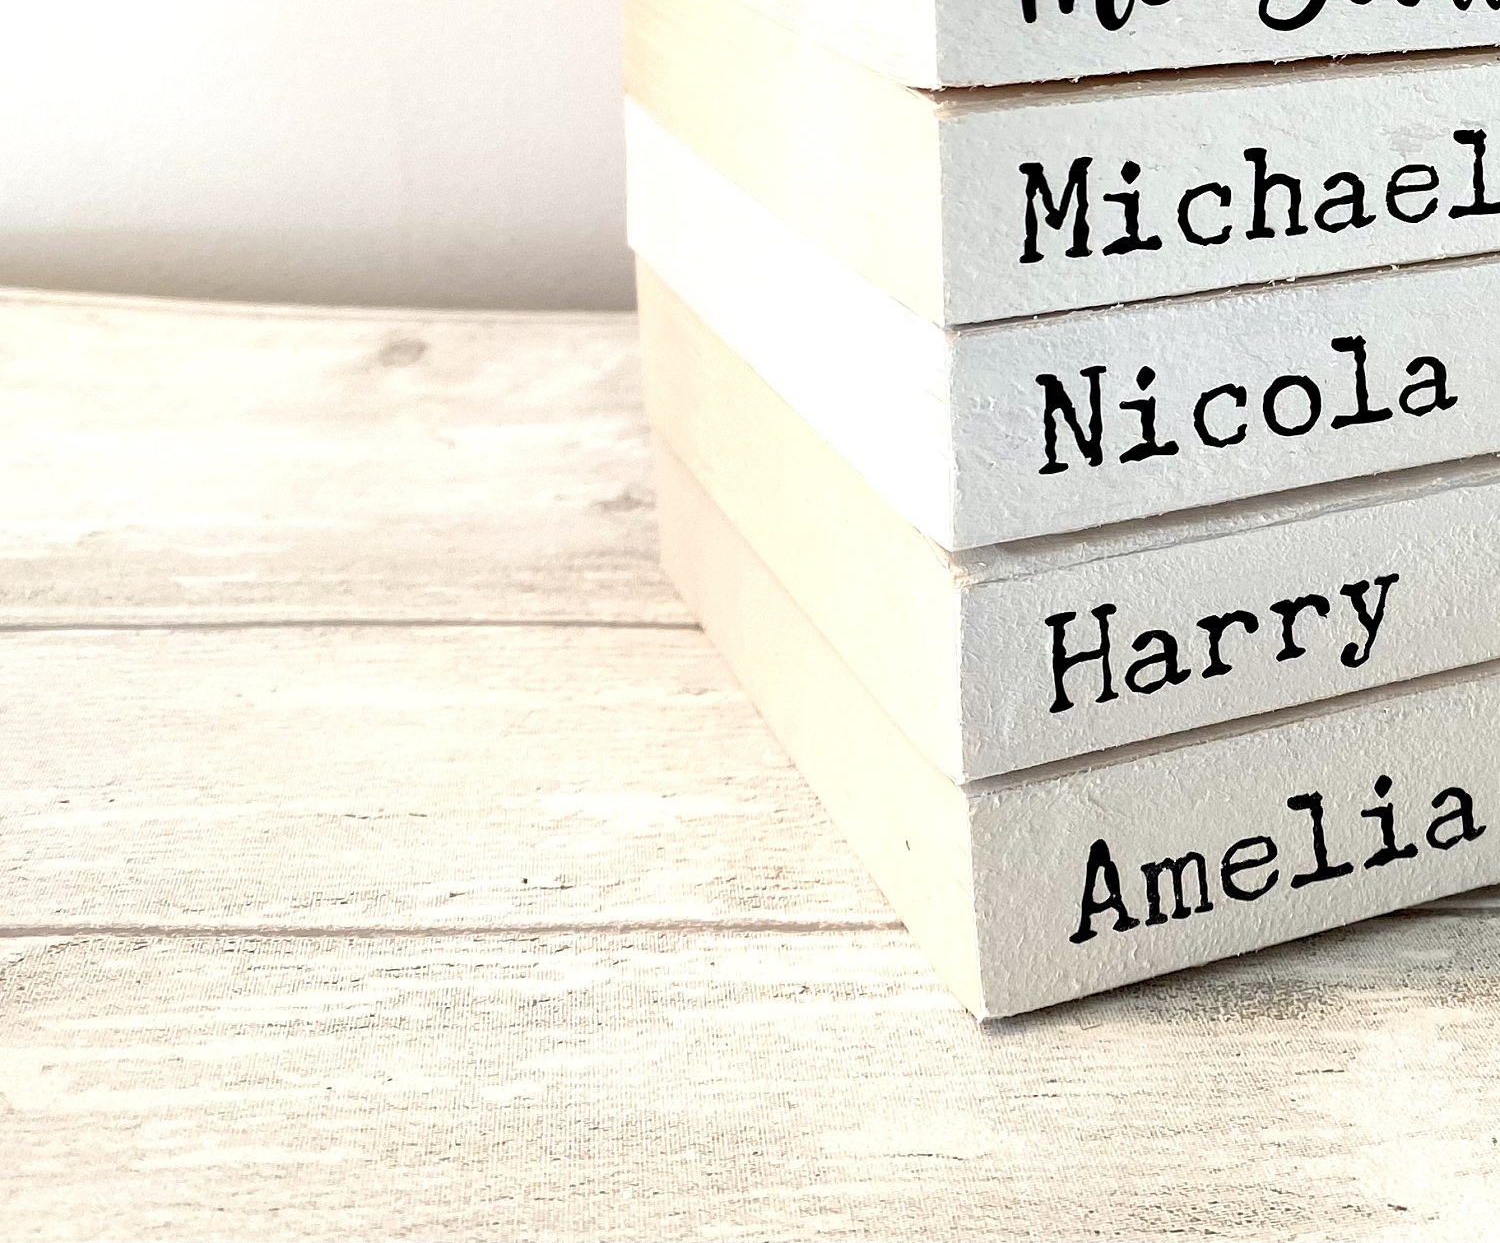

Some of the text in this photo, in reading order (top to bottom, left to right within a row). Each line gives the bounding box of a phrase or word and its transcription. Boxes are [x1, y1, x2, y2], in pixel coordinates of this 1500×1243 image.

[1036, 335, 1458, 474] Nicola
[1045, 573, 1399, 713] Harry
[1069, 775, 1486, 944] Amelia
